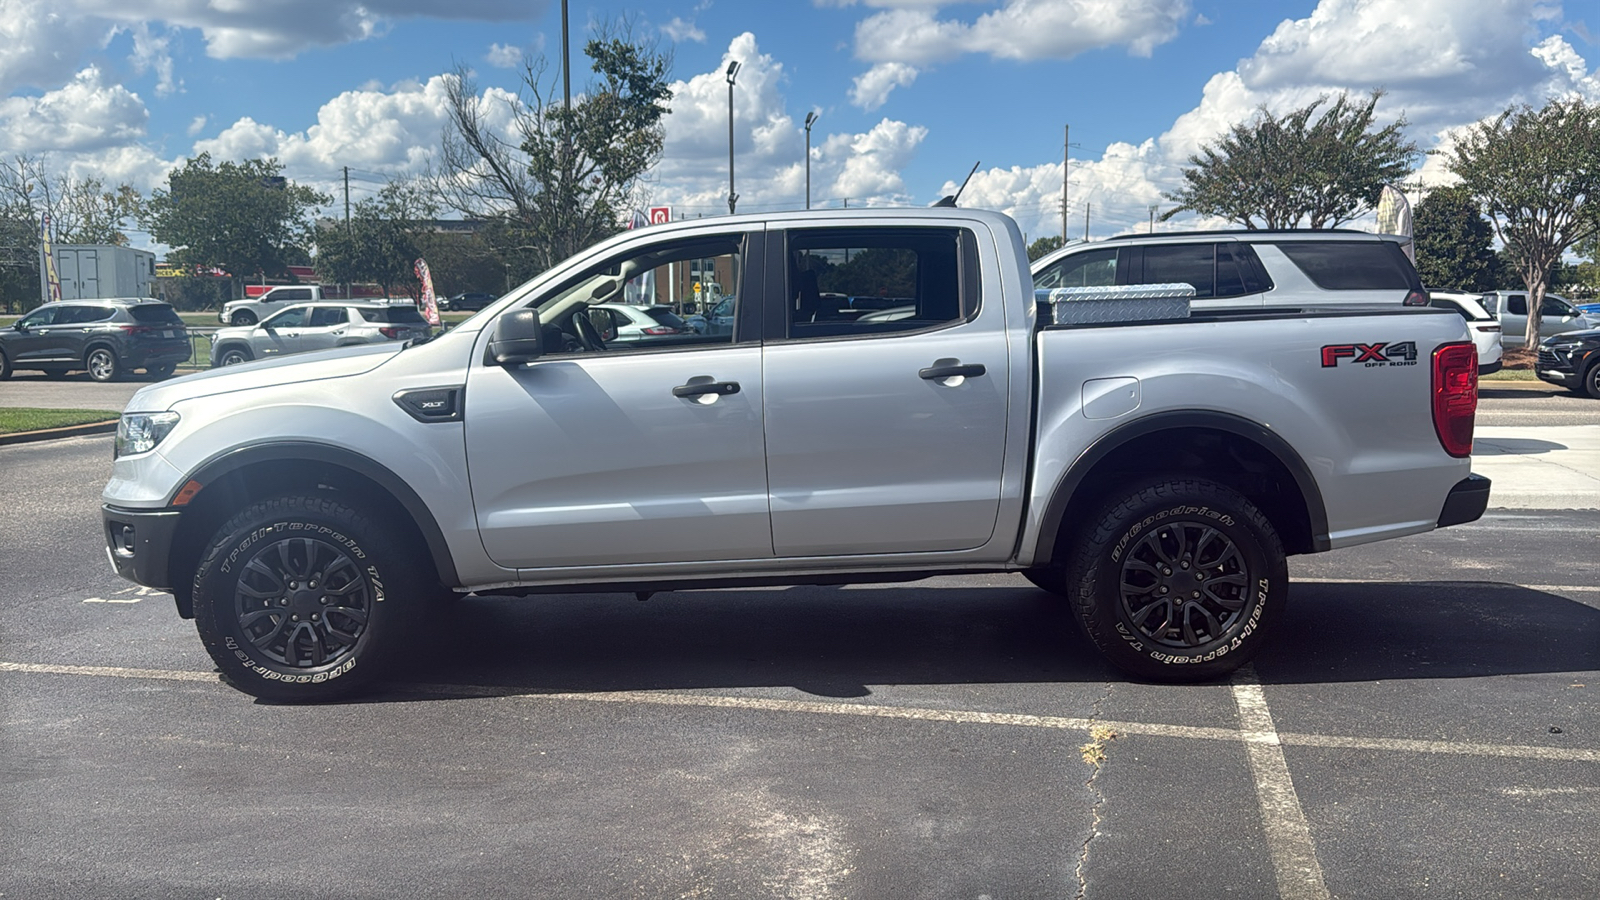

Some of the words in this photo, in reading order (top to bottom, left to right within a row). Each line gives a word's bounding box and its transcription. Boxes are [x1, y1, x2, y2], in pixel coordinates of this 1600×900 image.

[657, 213, 664, 224] K
[1320, 341, 1418, 368] FX4
[1111, 505, 1235, 563] BFGoodrich
[220, 522, 366, 574] Trail-Terrain
[367, 565, 385, 602] T/A
[1115, 621, 1144, 652] T/A
[1150, 578, 1269, 664] Trail-Terrain
[225, 636, 357, 684] BFGoodrich
